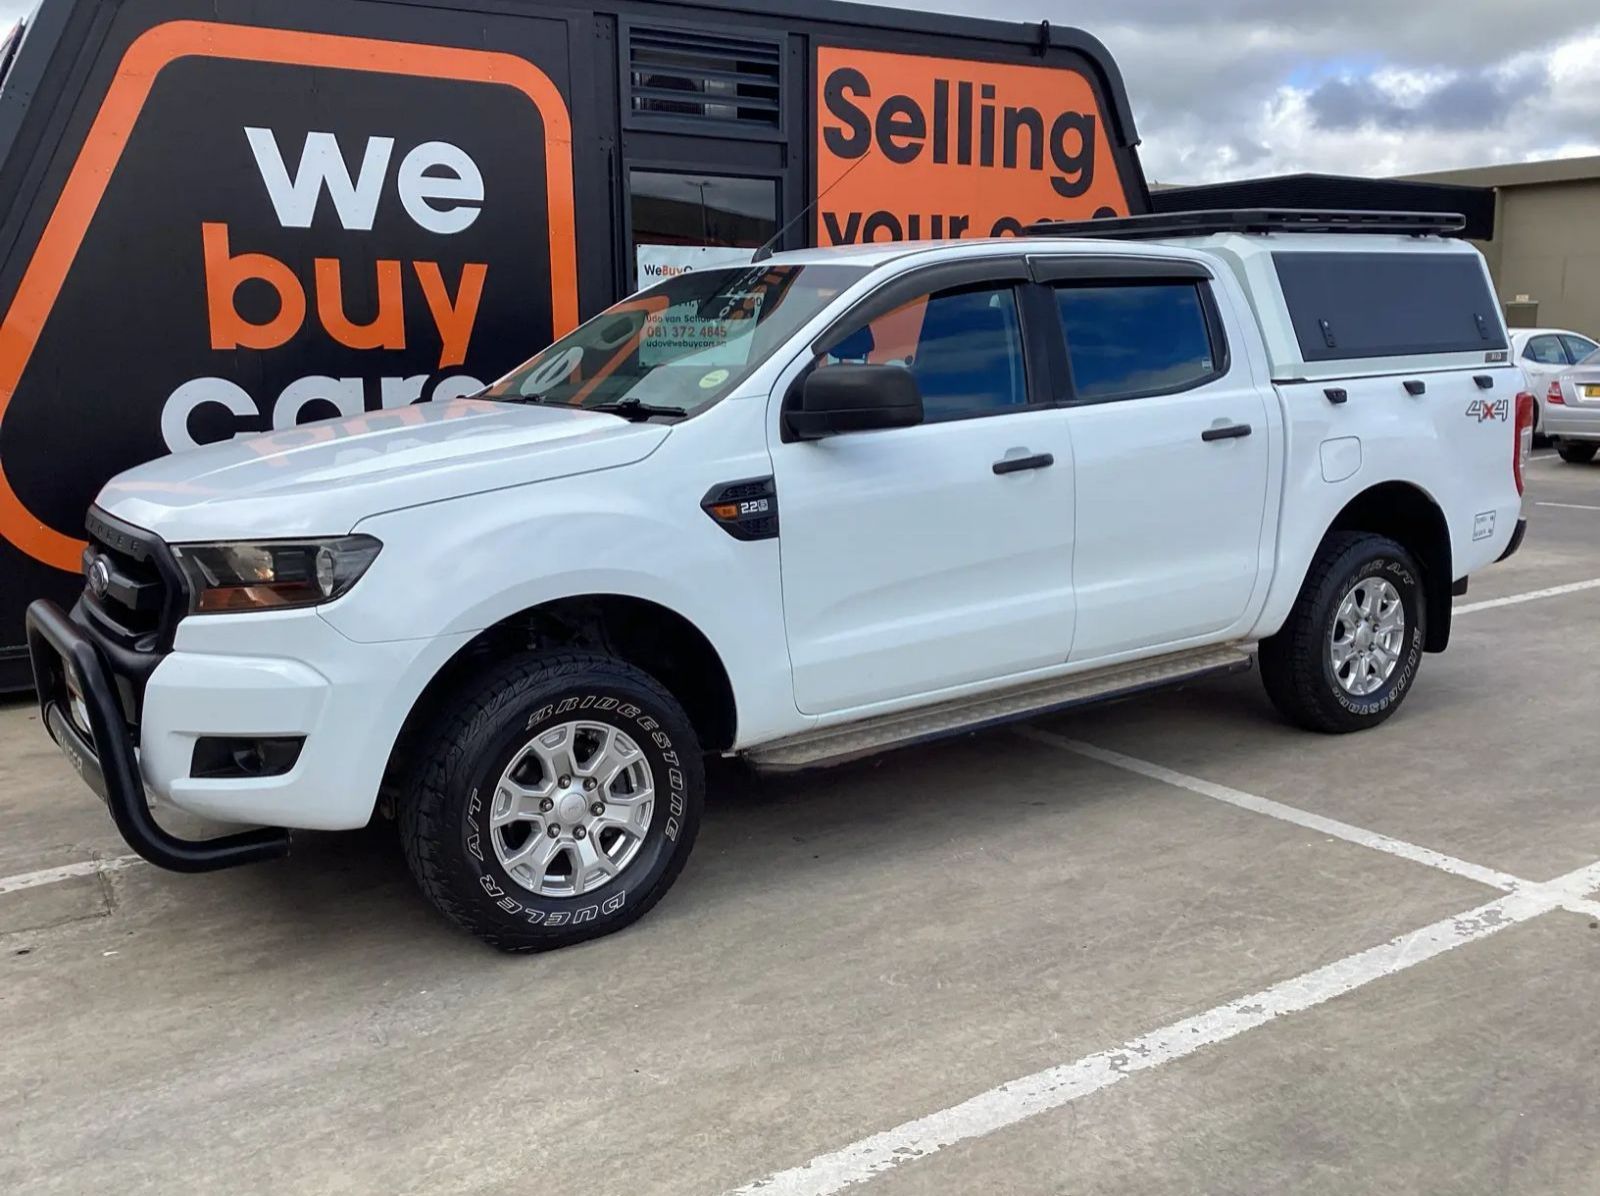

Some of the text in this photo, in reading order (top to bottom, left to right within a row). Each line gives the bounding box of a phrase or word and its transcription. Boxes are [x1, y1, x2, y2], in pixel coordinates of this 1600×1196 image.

[243, 126, 485, 234] we
[823, 67, 1096, 198] Selling
[202, 221, 488, 370] buy
[647, 326, 667, 338] 081
[672, 326, 695, 338] 372
[665, 315, 681, 323] van
[1465, 399, 1508, 423] 4x4
[525, 696, 684, 842] BRIDGESTONE
[466, 788, 626, 926] DUELER A/T
